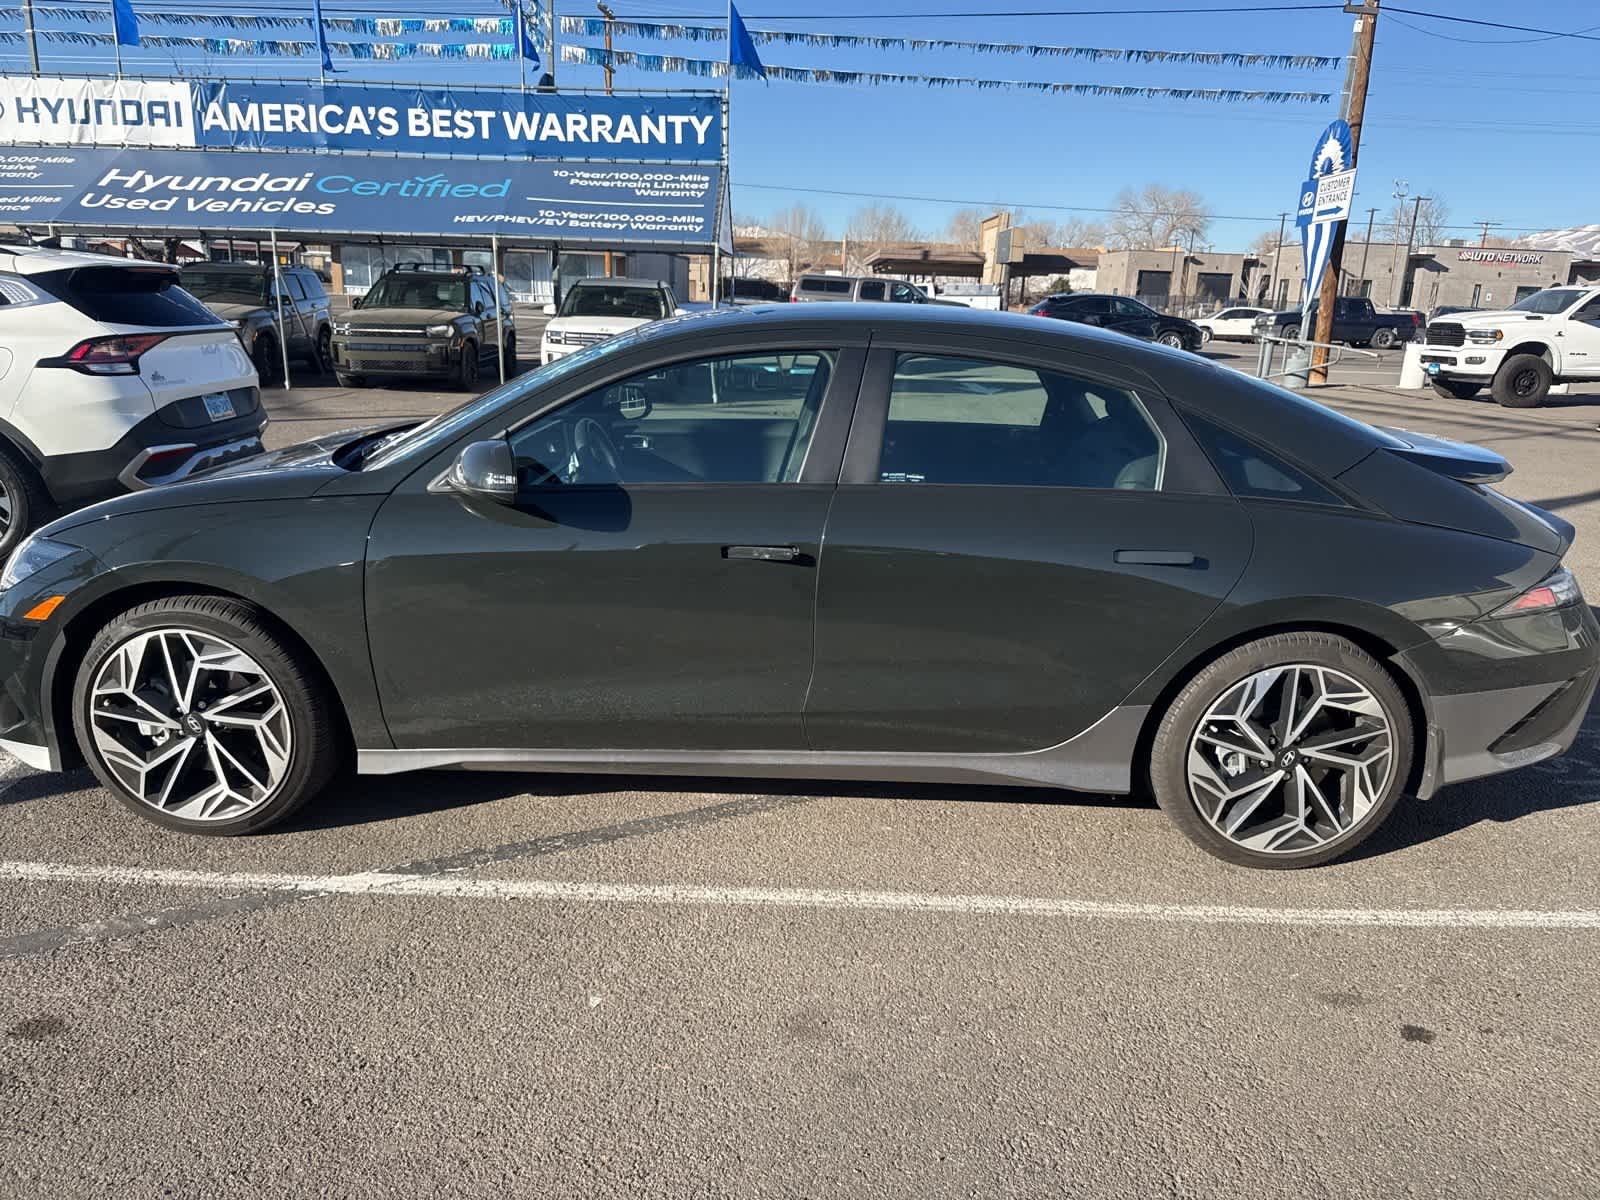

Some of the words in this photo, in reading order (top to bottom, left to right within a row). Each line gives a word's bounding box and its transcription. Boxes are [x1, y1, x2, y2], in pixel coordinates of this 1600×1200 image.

[15, 97, 183, 127] HYUNDAI
[408, 108, 496, 139] BEST
[503, 112, 714, 145] WARRANTY
[97, 168, 314, 193] Hyundai
[315, 173, 511, 200] Certified
[569, 178, 650, 189] Powertrain
[653, 180, 709, 190] Limited
[1320, 177, 1351, 192] CUSTOMER
[21, 195, 63, 203] Miles
[635, 189, 705, 198] Warranty
[1318, 190, 1348, 206] ENTRANCE
[80, 193, 179, 211] Used
[185, 196, 337, 215] Vehicles
[454, 215, 566, 226] HEV/PHEV/EV
[568, 219, 628, 231] Battery
[630, 222, 704, 233] Warranty
[1496, 252, 1543, 264] NETWORK
